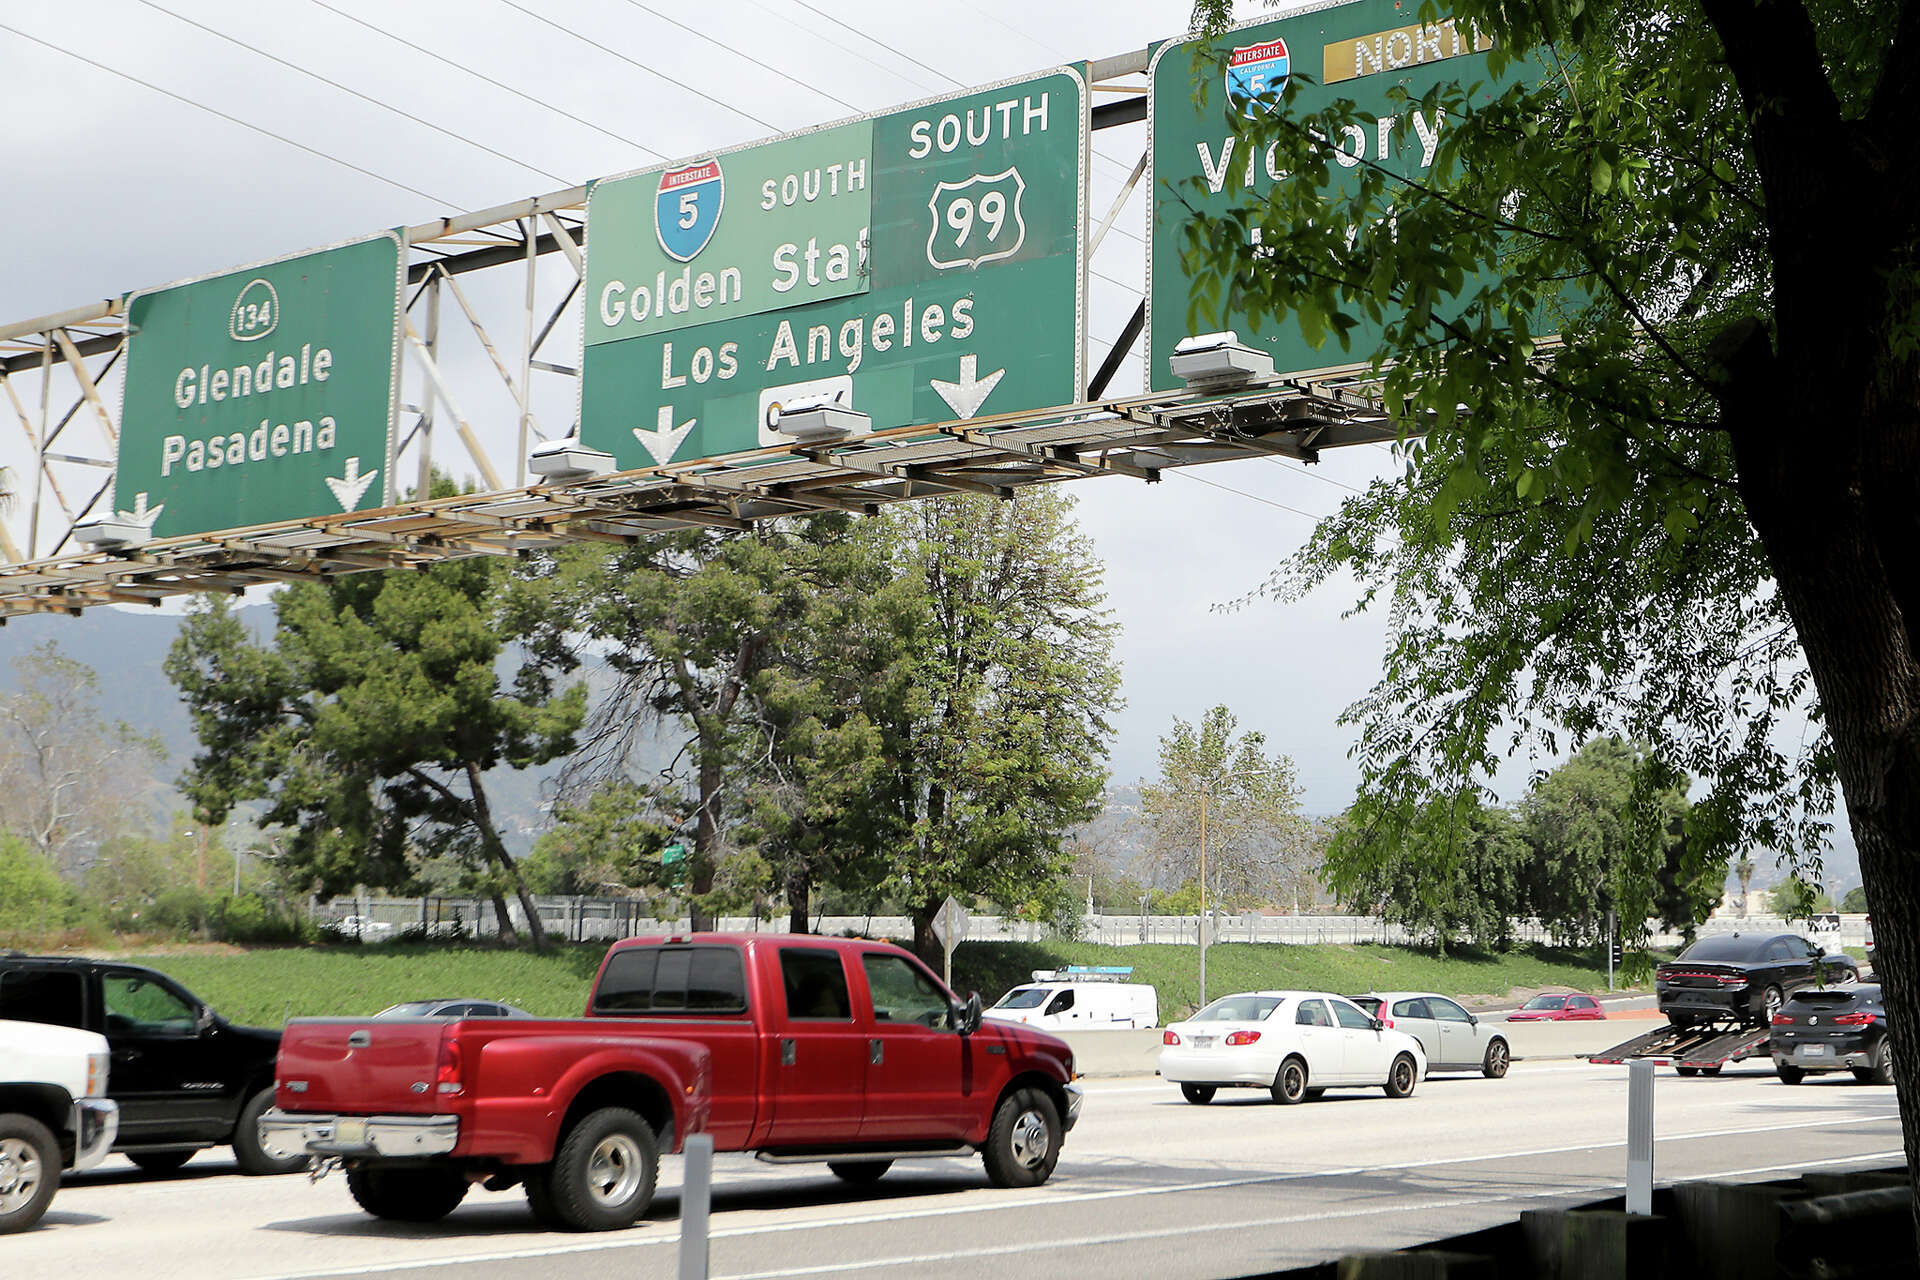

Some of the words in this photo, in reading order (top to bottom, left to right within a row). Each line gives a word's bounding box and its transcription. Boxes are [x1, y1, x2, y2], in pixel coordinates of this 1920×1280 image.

[1235, 45, 1281, 64] INTERSTATE
[1239, 62, 1276, 75] CALIFORNIA
[1250, 74, 1267, 102] 5
[908, 92, 1049, 159] SOUTH
[1196, 106, 1447, 194] Vicory
[668, 166, 712, 186] INTERSTATE
[760, 158, 867, 211] SOUTH
[678, 191, 699, 230] 5
[946, 190, 1007, 249] 99
[237, 300, 271, 331] 134
[600, 265, 742, 328] Golden
[661, 341, 739, 390] Los
[766, 296, 976, 374] Angeles
[174, 343, 333, 409] Glendale
[161, 415, 337, 478] Pasadena
